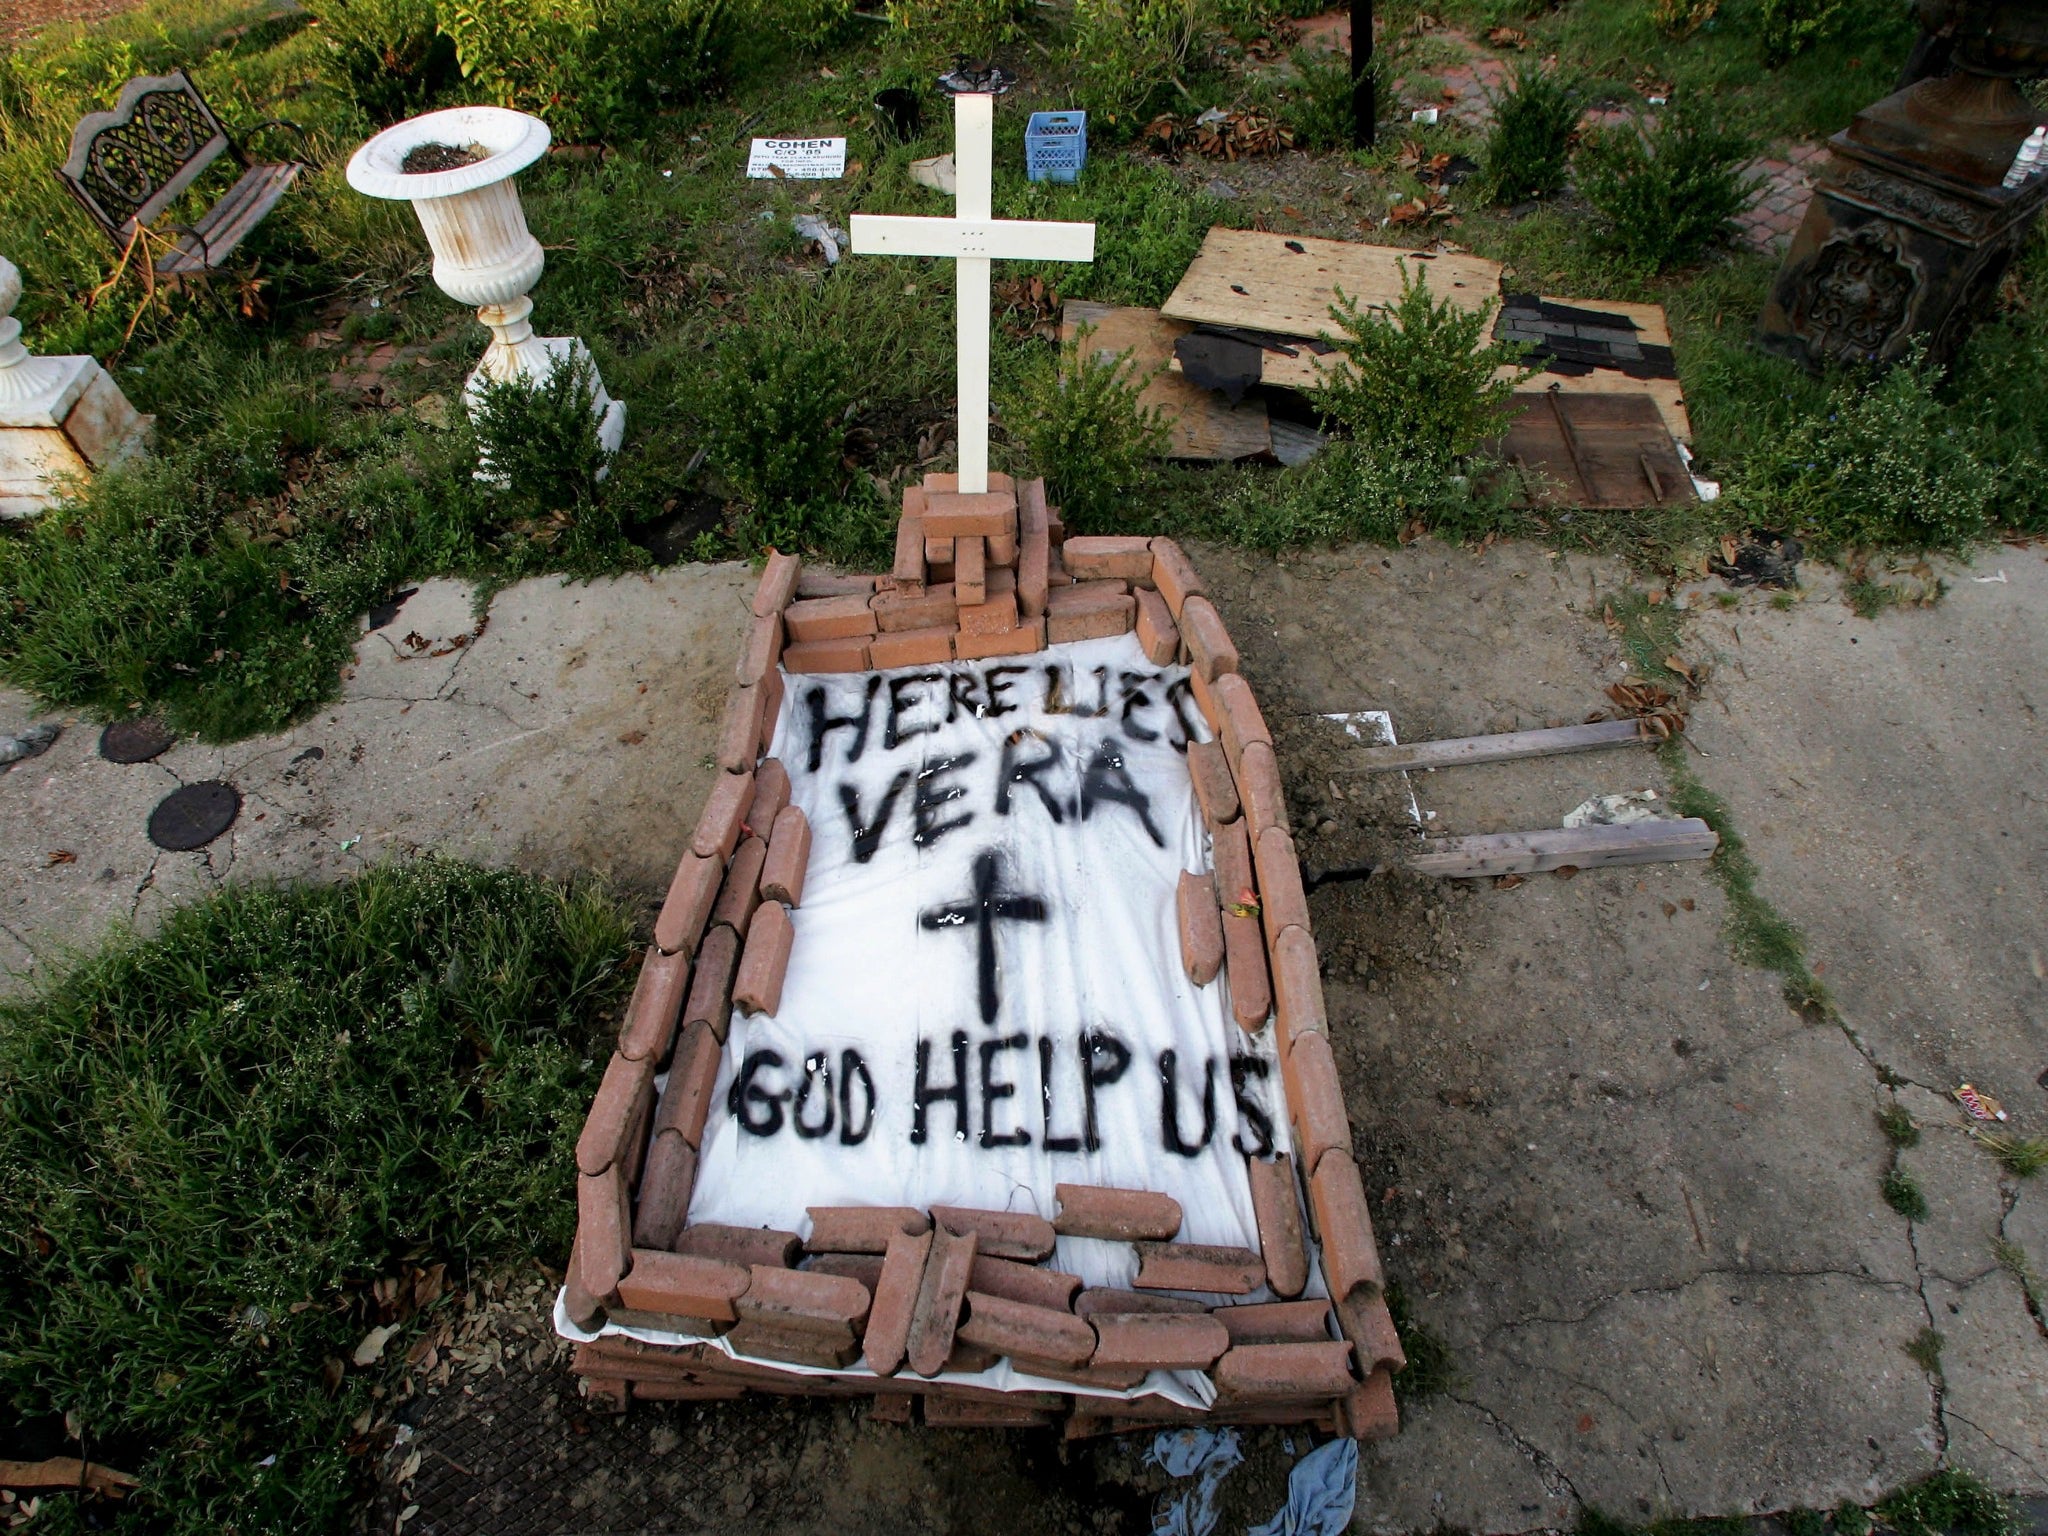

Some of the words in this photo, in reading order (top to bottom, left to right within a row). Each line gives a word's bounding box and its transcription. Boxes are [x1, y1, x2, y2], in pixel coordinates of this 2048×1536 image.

[765, 140, 832, 149] COHEN
[806, 665, 1028, 772] HERE
[1044, 664, 1194, 754] LIES
[838, 728, 1166, 864] VERA
[729, 1047, 877, 1145] GOD
[910, 1029, 1132, 1153] HELP
[1161, 1047, 1277, 1157] US
